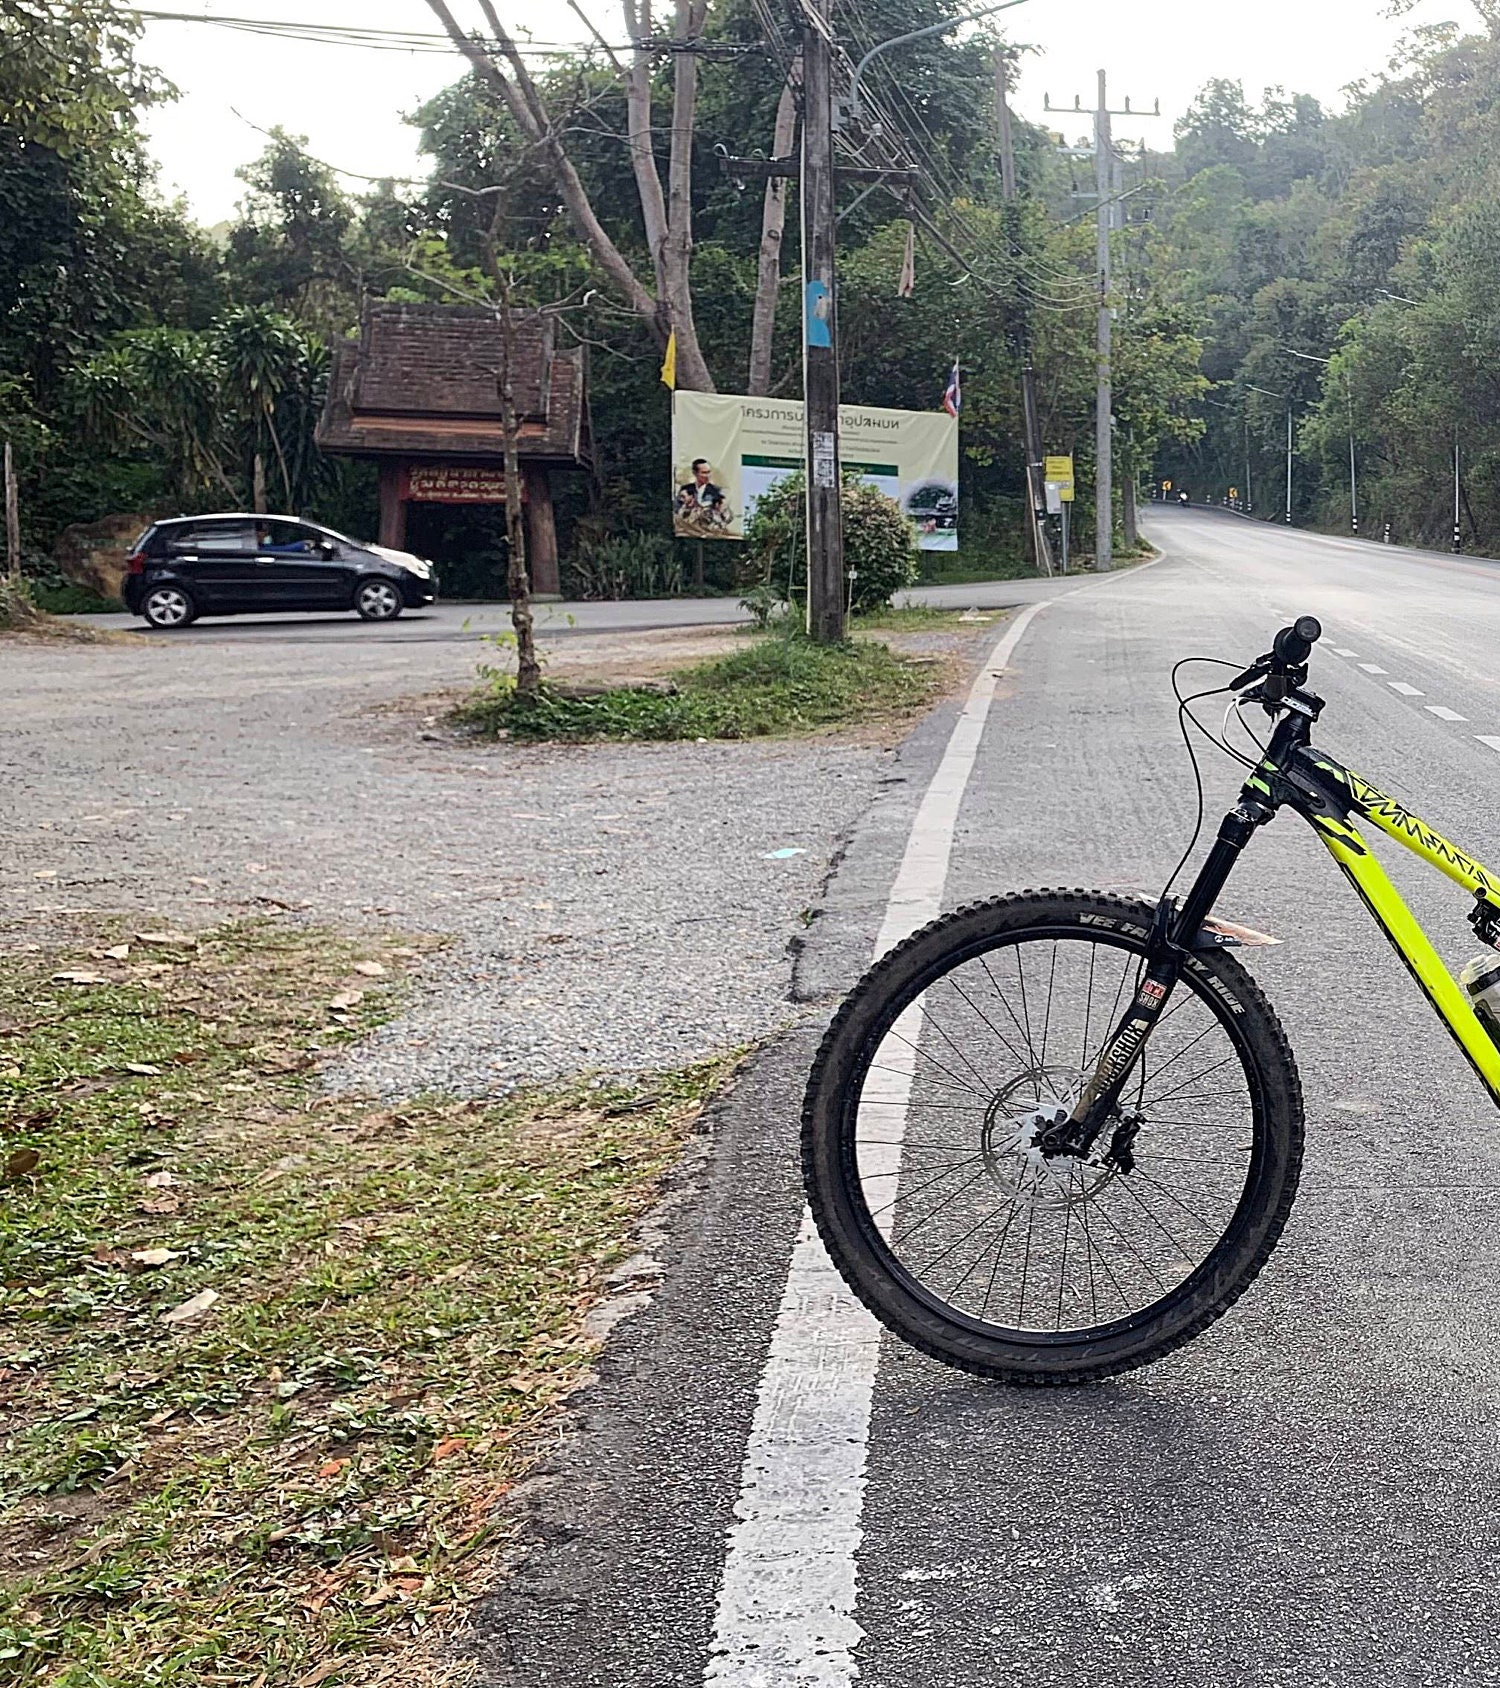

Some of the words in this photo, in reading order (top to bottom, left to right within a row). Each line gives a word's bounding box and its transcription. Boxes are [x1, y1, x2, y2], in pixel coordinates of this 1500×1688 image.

[1079, 912, 1115, 930] VEE
[1207, 976, 1246, 1015] RIDE
[1138, 991, 1162, 1010] SHOX
